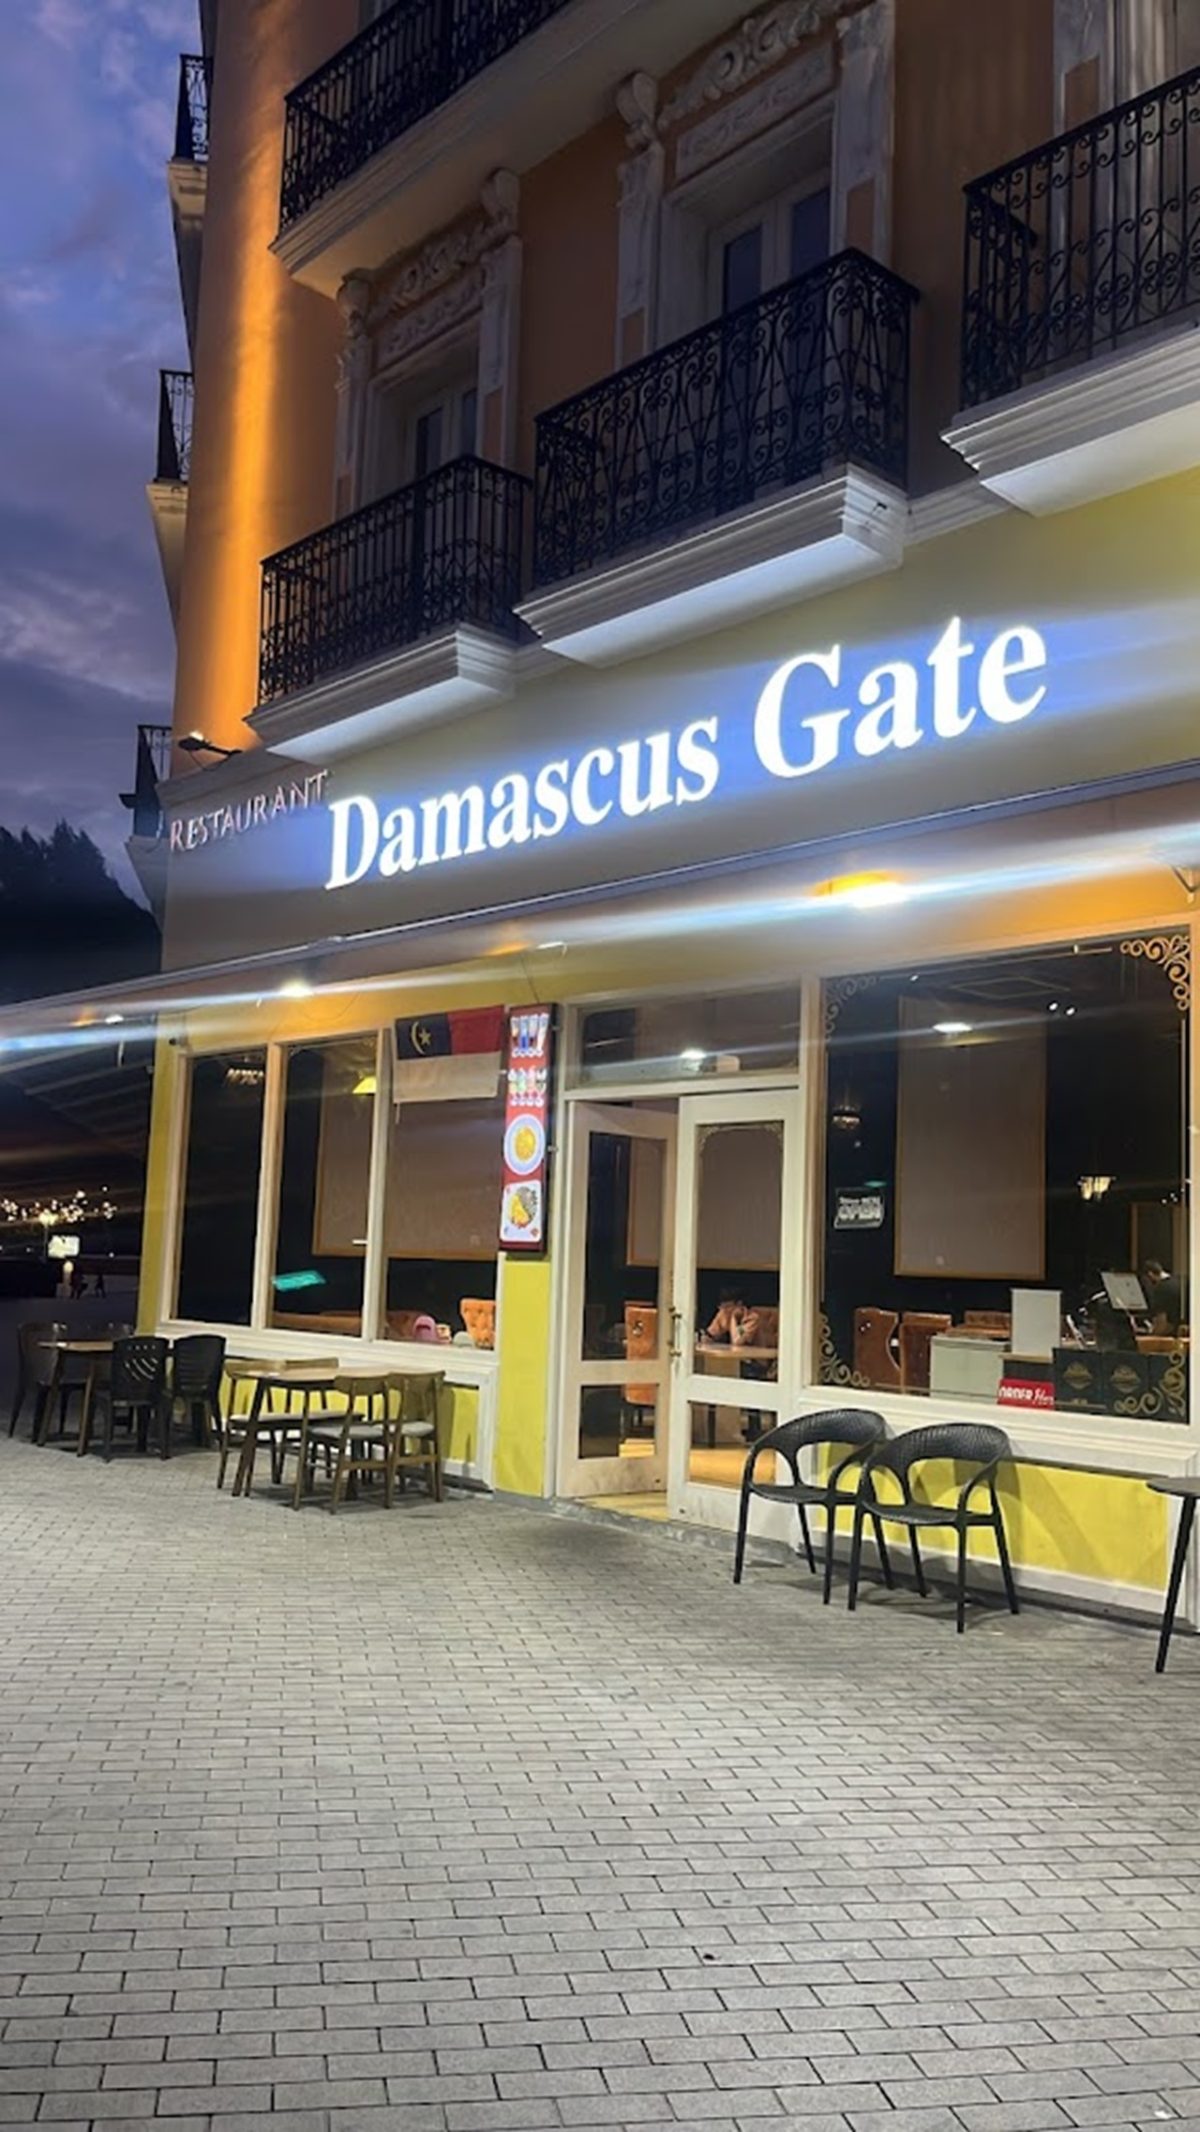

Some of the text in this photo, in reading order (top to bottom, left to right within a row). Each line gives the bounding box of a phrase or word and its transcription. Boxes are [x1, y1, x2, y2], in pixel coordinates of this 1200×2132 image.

[170, 768, 329, 851] RESTAURANT
[325, 615, 1047, 890] Damascus Gate
